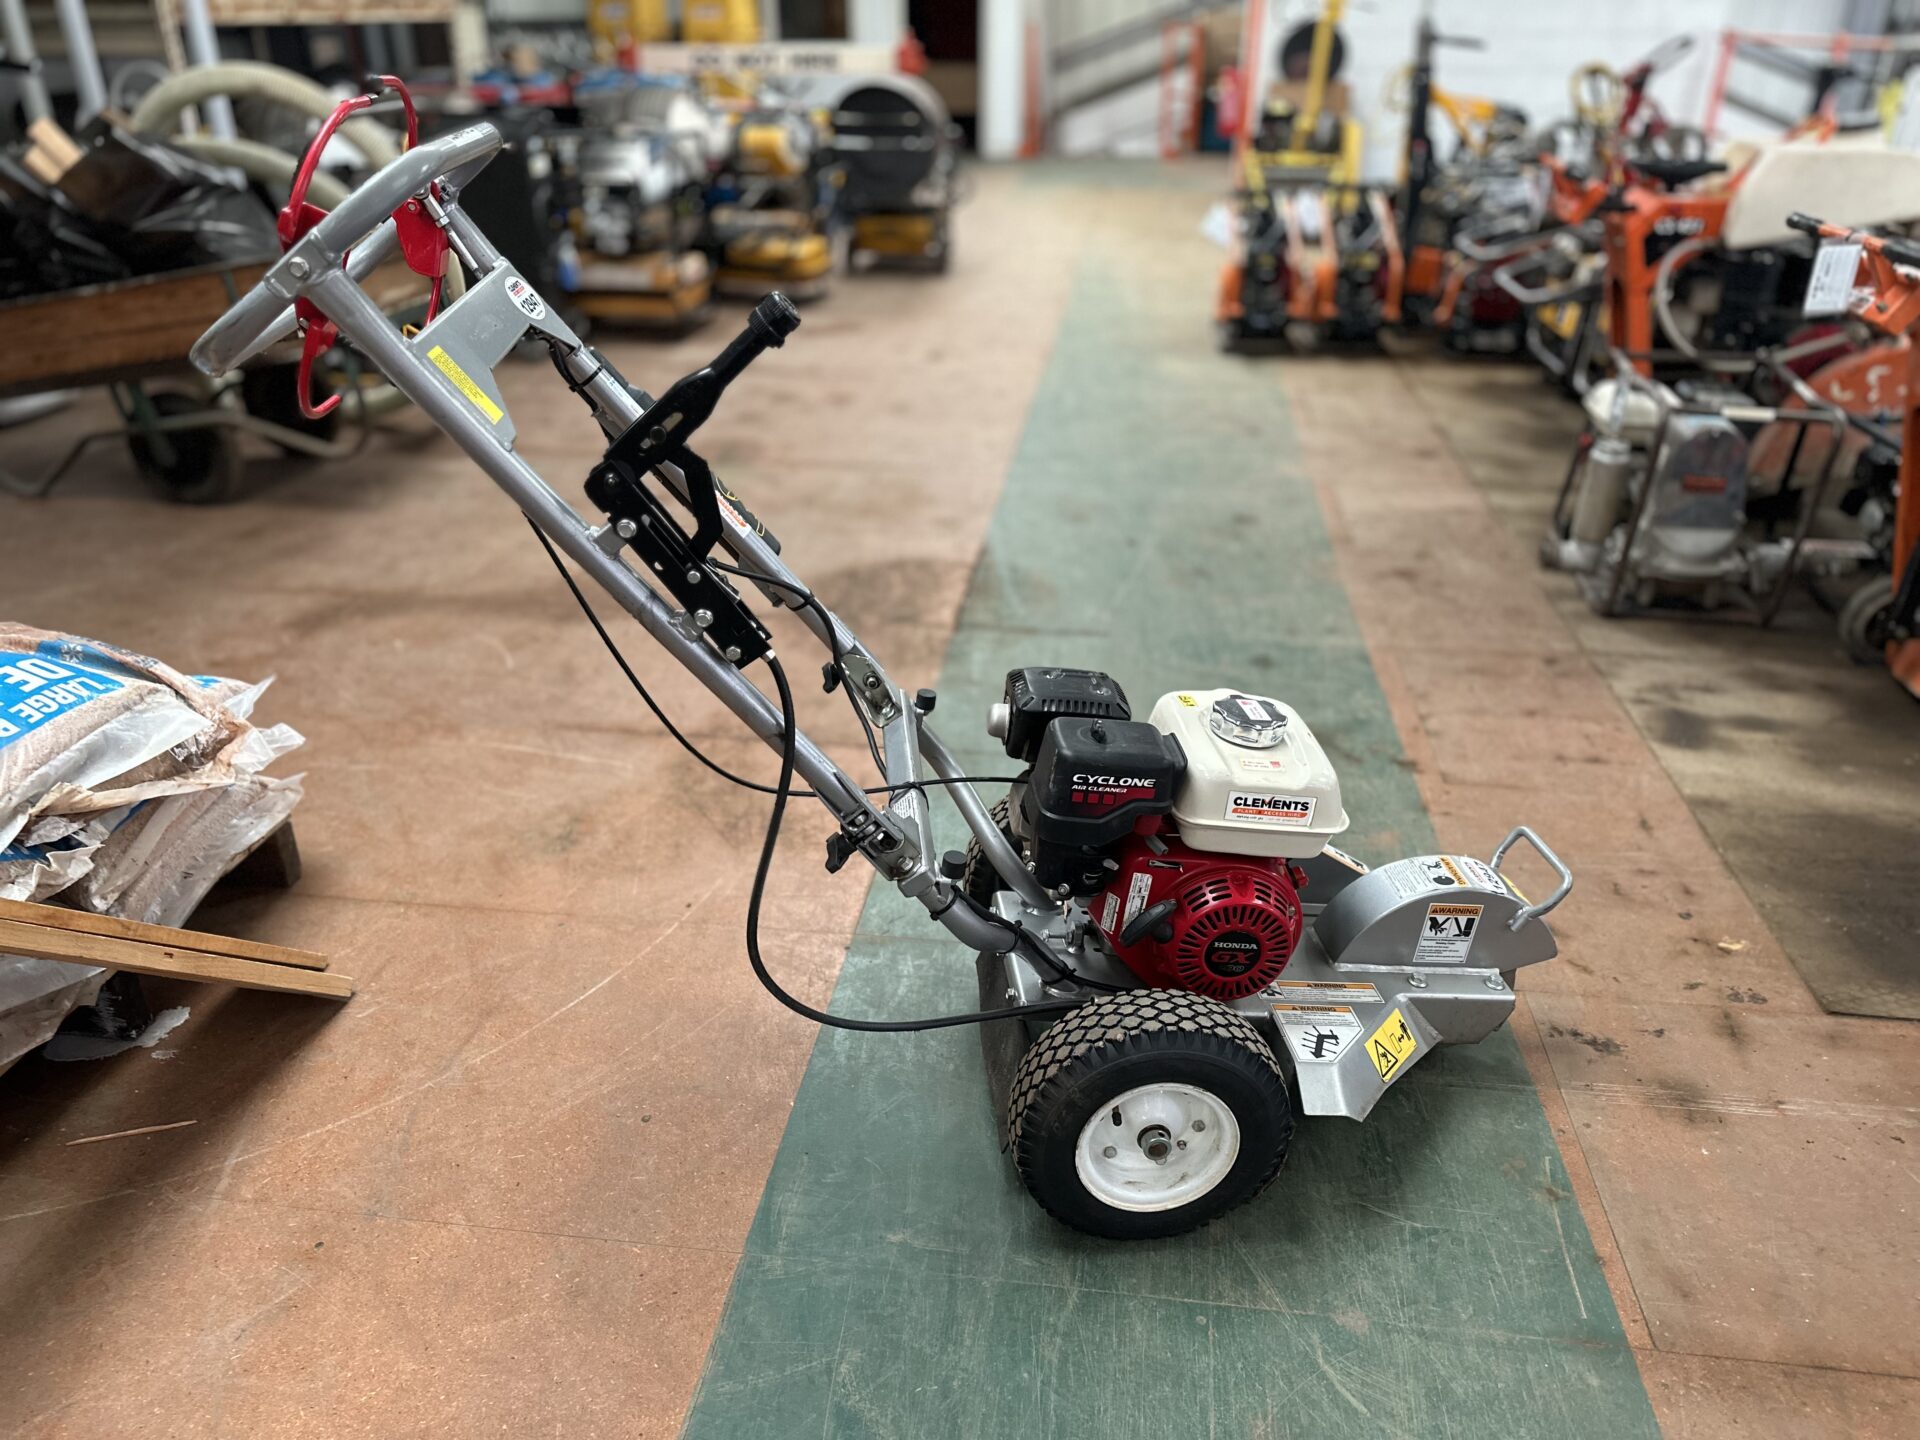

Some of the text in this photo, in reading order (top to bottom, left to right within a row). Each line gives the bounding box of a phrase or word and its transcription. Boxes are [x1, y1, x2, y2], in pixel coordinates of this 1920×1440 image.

[0, 658, 77, 693] DE
[8, 676, 106, 724] LARGE
[1072, 774, 1156, 787] CYCLONE
[1088, 785, 1128, 793] CLEANER
[1233, 796, 1310, 811] CLEMENTS
[1439, 907, 1479, 915] WARNING
[1214, 941, 1259, 950] HONDA
[1211, 951, 1255, 964] GX
